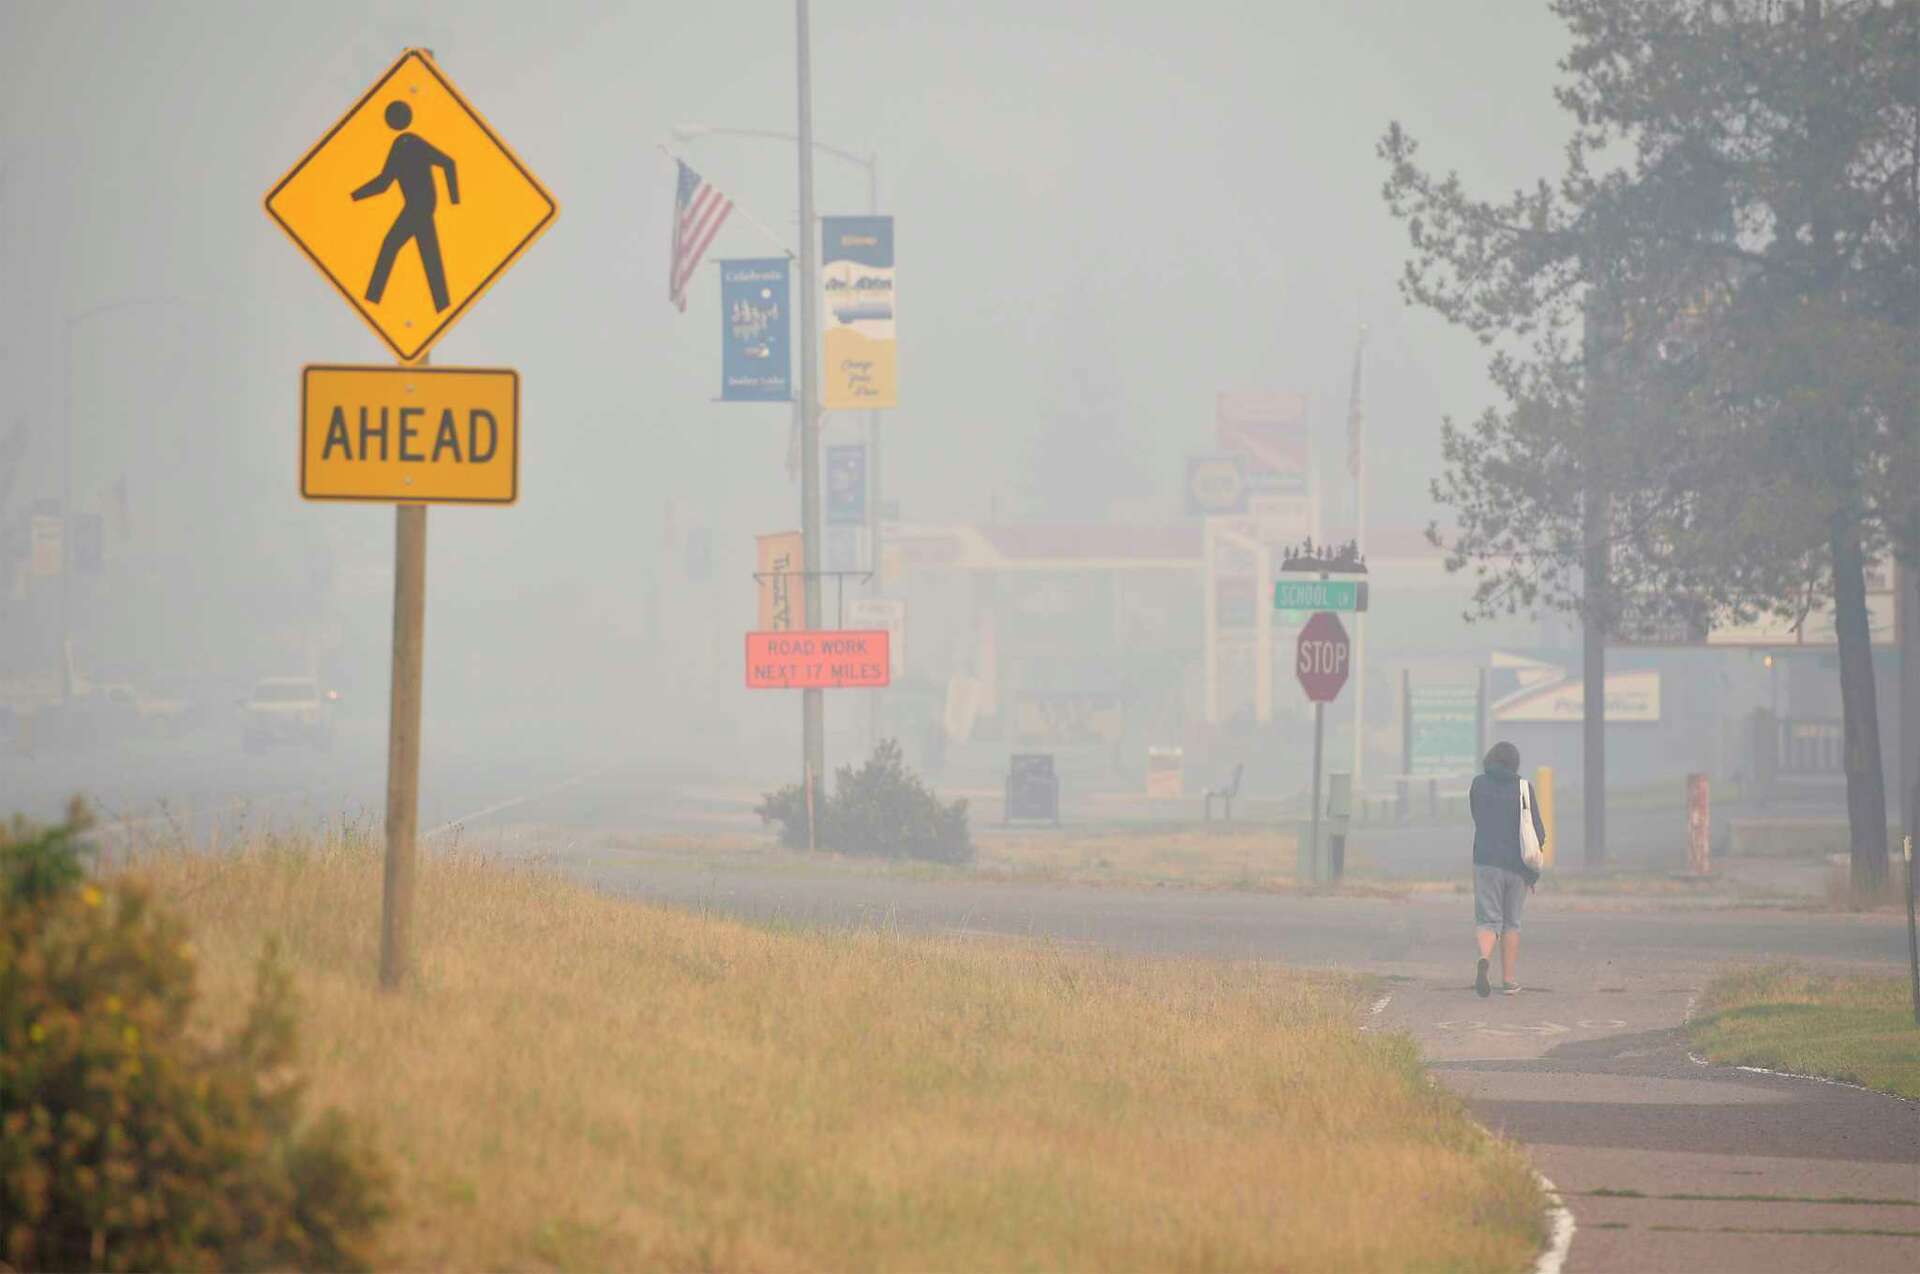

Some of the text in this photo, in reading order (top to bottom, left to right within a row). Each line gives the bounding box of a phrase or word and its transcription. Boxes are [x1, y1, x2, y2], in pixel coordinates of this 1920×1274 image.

[322, 405, 498, 463] AHEAD
[1280, 584, 1328, 607] SCHOOL
[768, 639, 867, 655] ROAD WORK
[1300, 641, 1346, 674] STOP
[755, 663, 881, 679] NEXT 17 MILES
